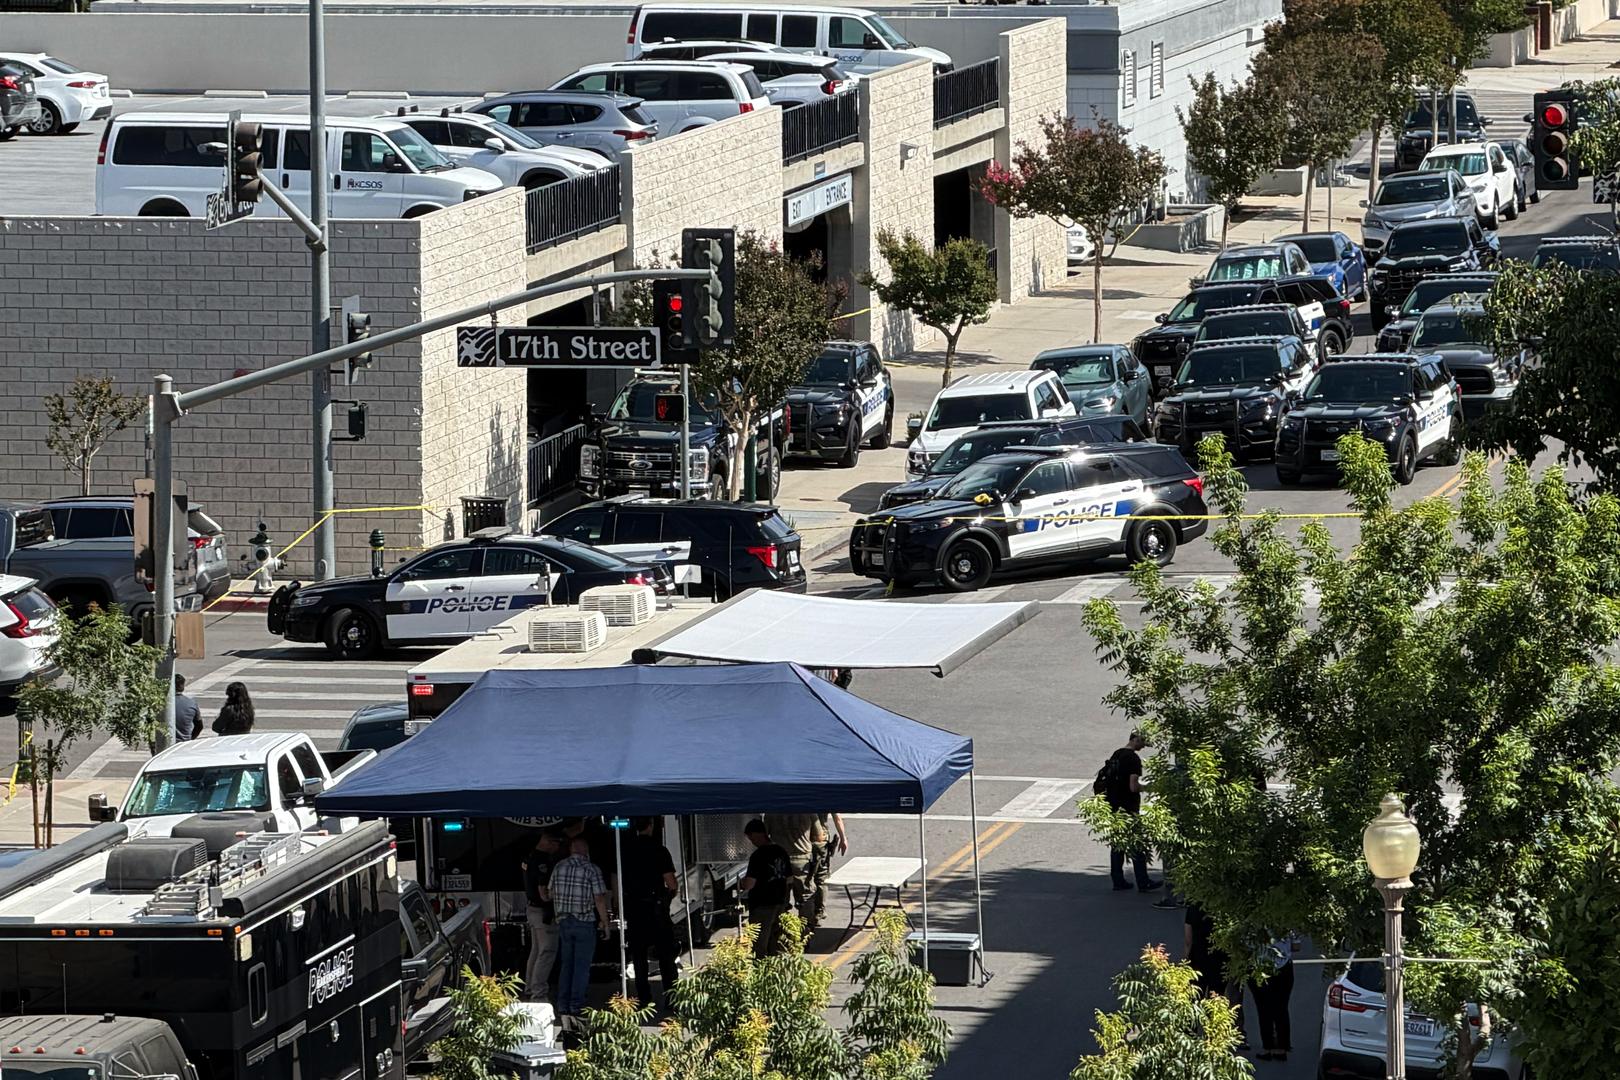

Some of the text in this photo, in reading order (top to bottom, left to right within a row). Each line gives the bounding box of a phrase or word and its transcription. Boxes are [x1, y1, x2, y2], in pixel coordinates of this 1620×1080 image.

[354, 180, 383, 189] KCSOS
[792, 181, 847, 220] EXIT ENTRANCE
[508, 335, 652, 360] 17th Street
[1041, 502, 1113, 531] POLICE
[427, 595, 509, 614] POLICE
[307, 945, 355, 1009] POLICE
